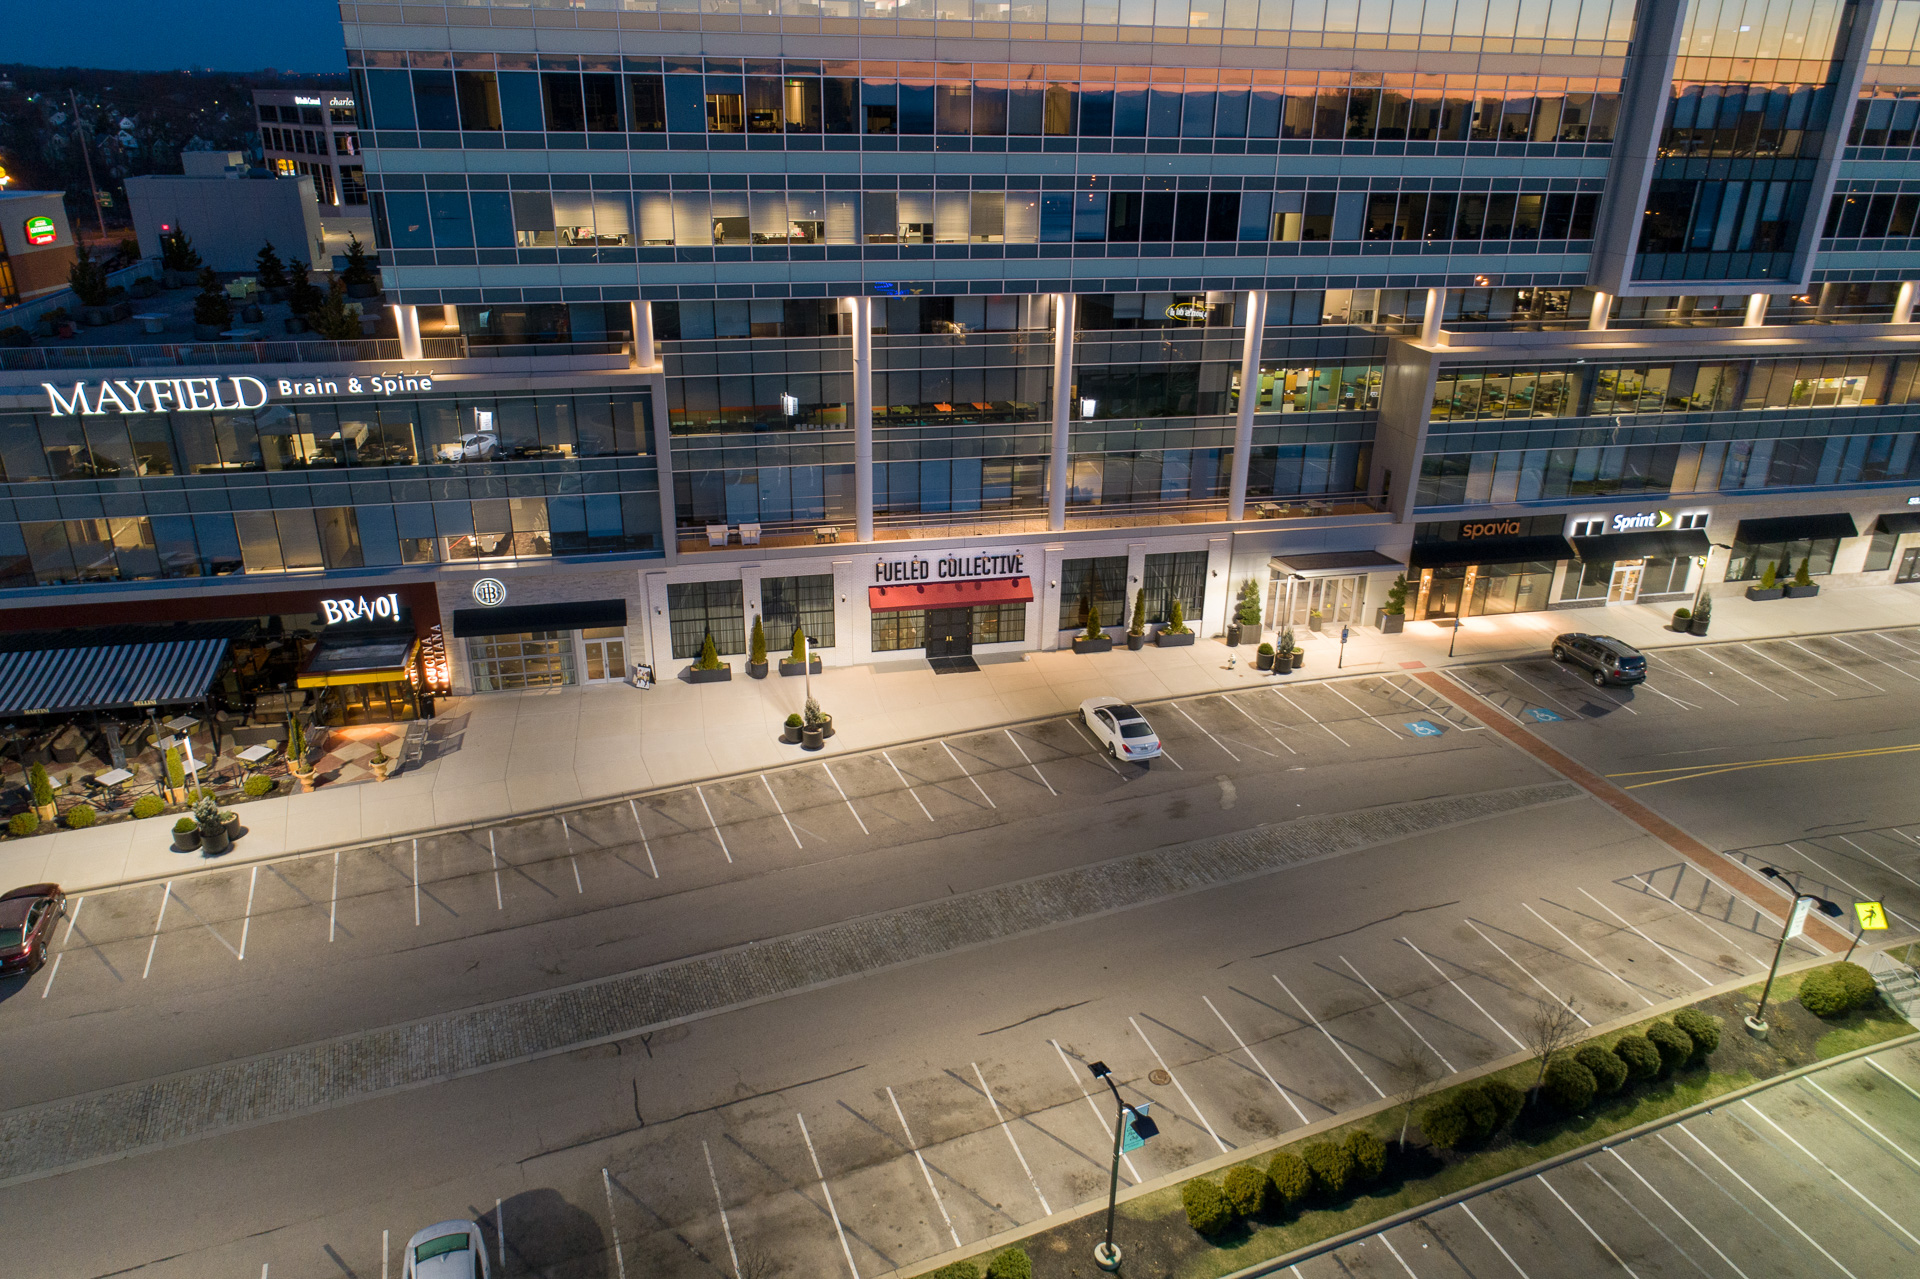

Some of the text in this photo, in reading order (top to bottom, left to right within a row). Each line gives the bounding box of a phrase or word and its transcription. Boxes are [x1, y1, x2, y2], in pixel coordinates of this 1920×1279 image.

[41, 376, 432, 416] MAYFIELD Brain & Spine
[1462, 519, 1520, 540] spavia
[1612, 512, 1656, 532] Sprint
[875, 554, 1024, 582] FUELED COLLECTIVE
[321, 593, 400, 625] BRAVO!
[421, 637, 438, 683] CUCINA
[430, 624, 449, 682] ITALIANA
